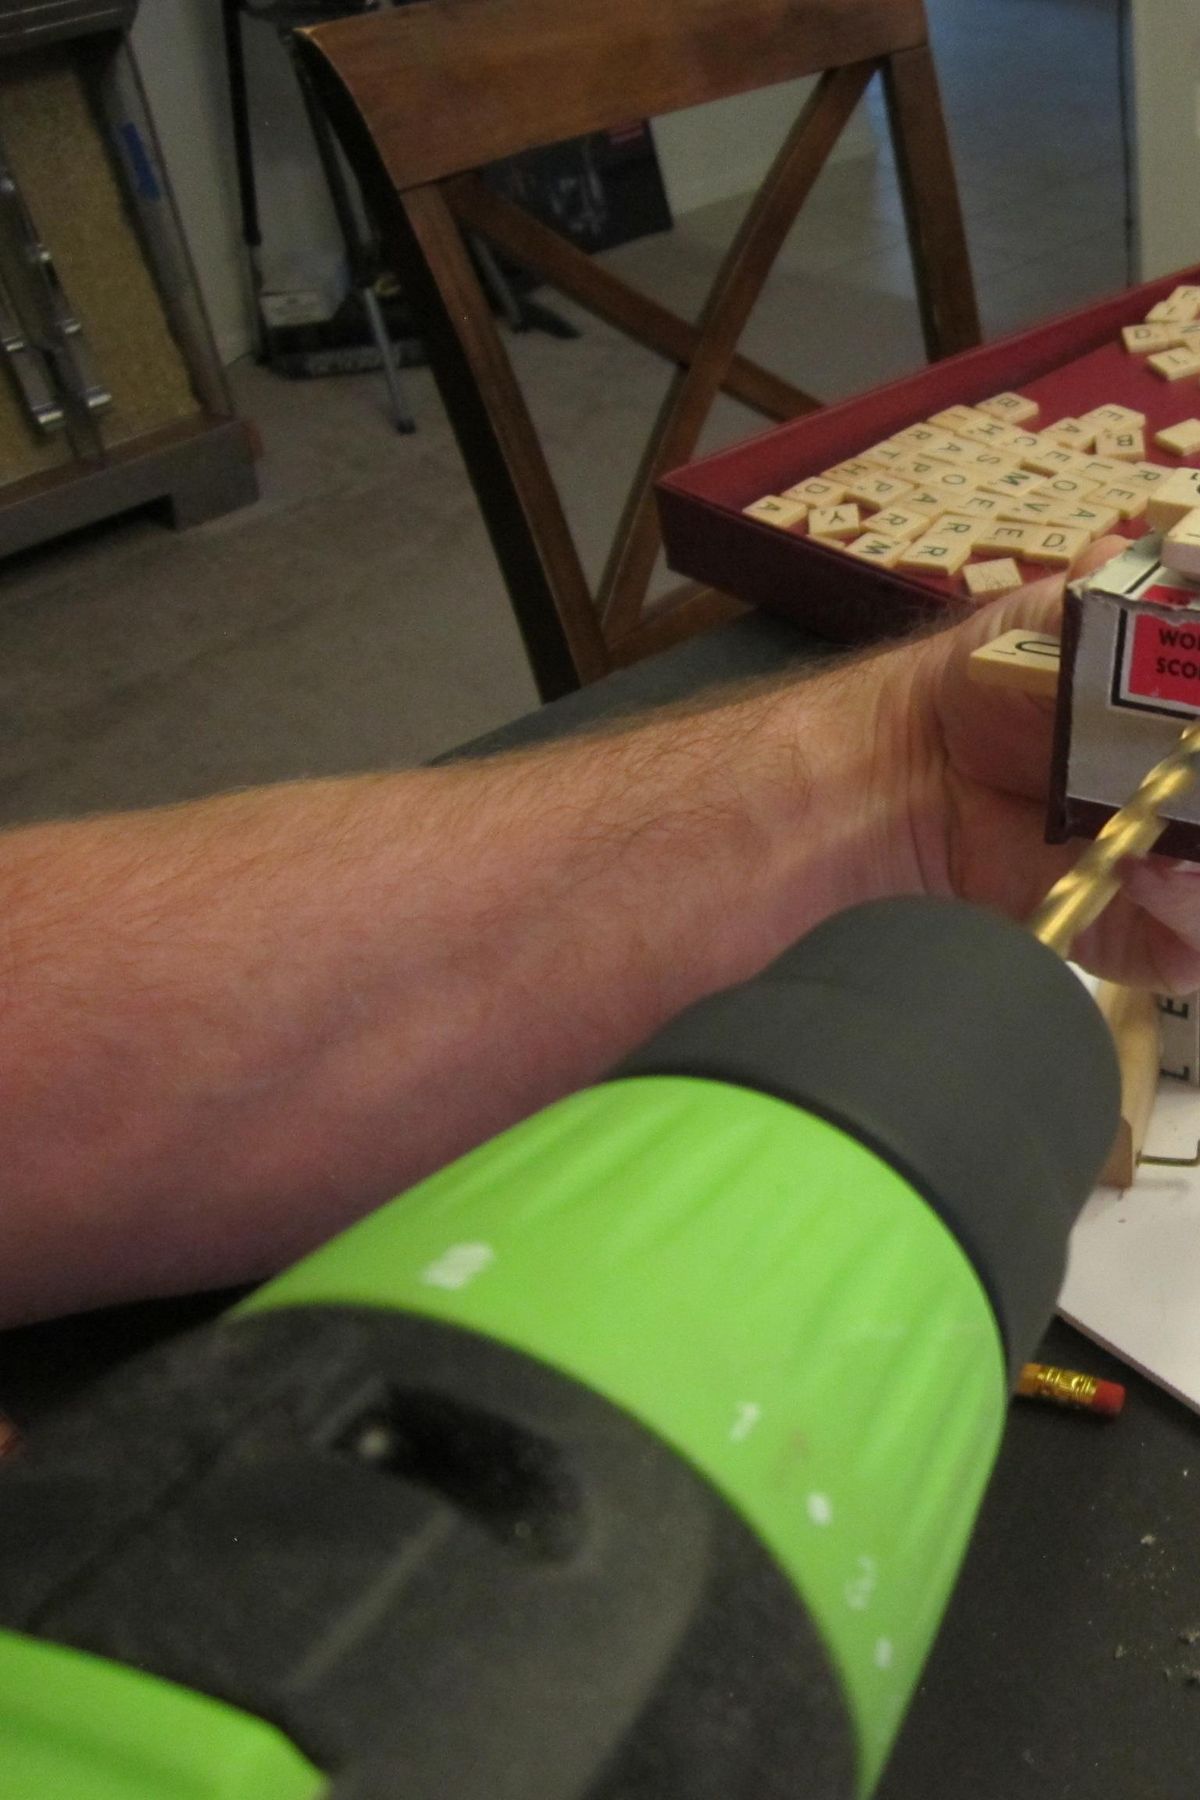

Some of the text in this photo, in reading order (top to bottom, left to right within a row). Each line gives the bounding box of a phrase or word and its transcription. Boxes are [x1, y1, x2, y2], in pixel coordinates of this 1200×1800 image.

[1116, 434, 1134, 447] B
[941, 474, 967, 486] O
[1052, 479, 1078, 492] O
[828, 510, 847, 526] Y
[994, 527, 1025, 539] E
[1041, 532, 1066, 548] D
